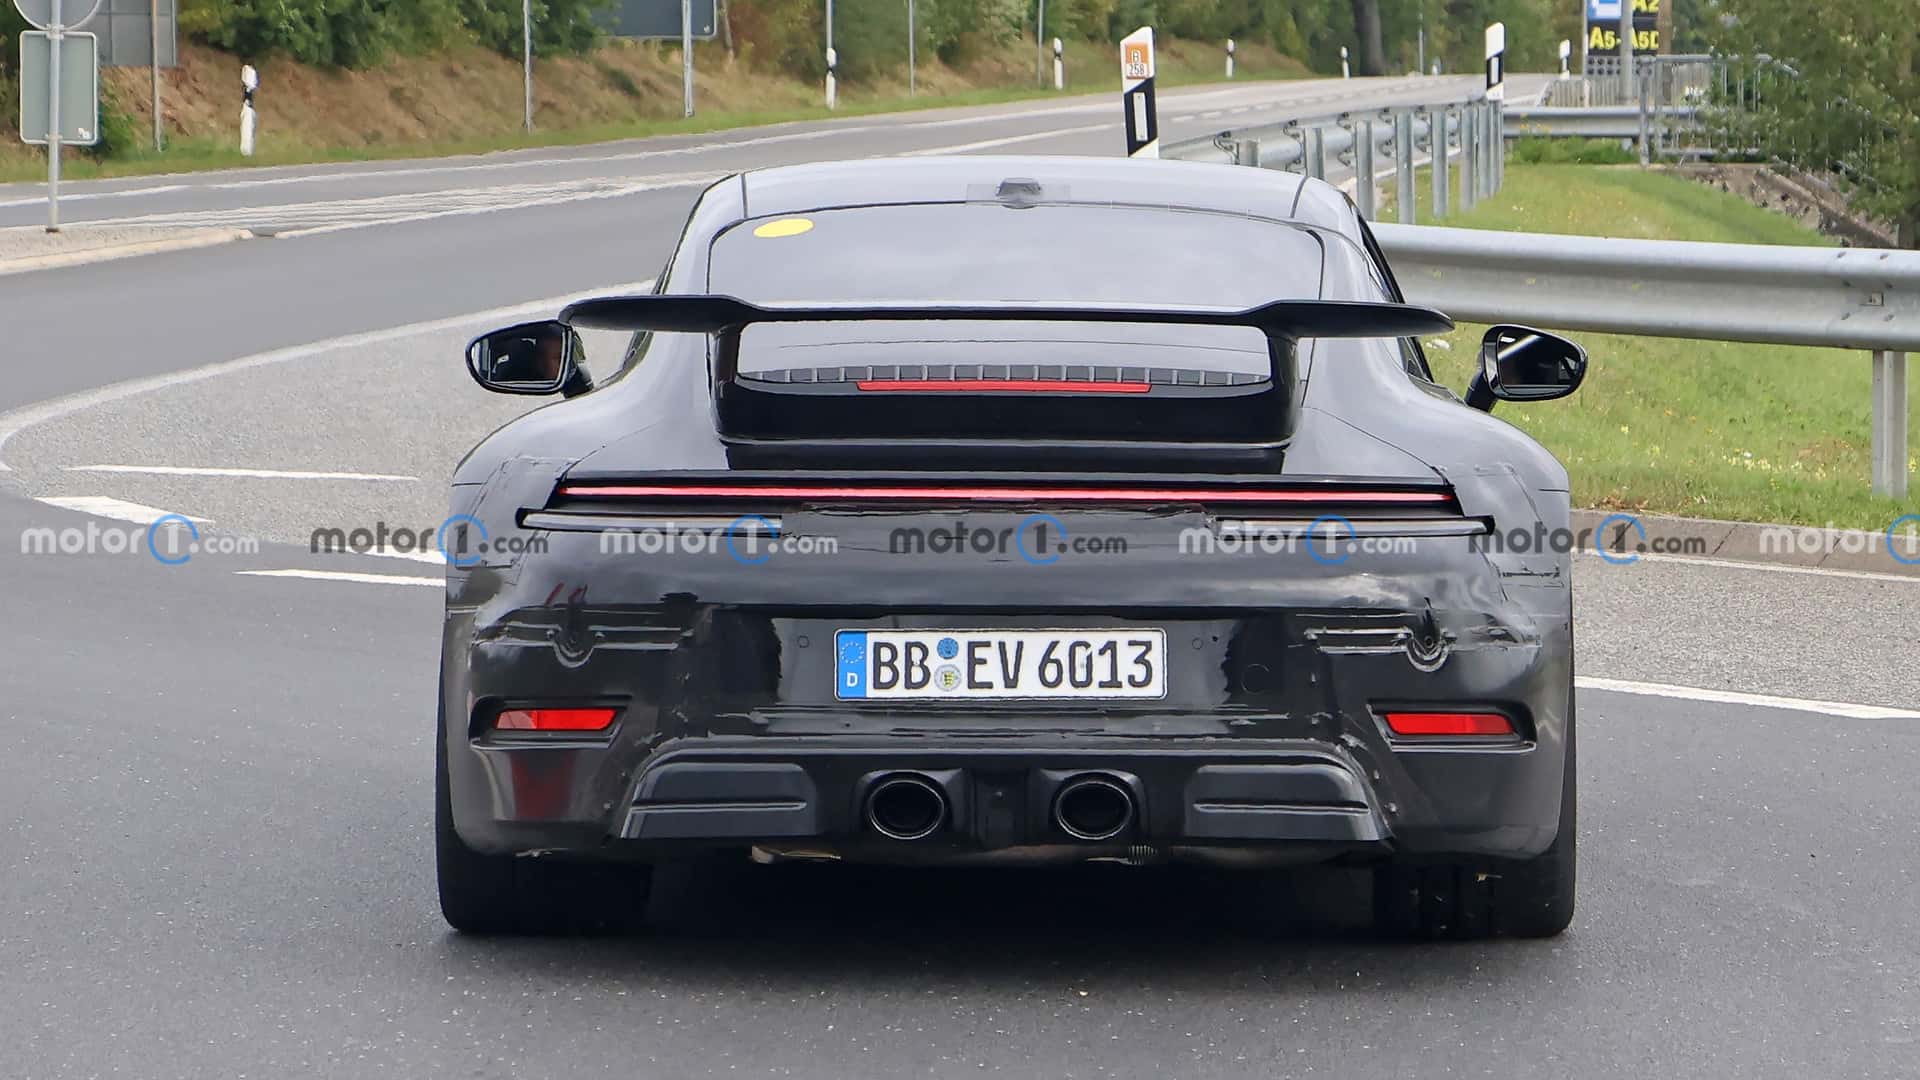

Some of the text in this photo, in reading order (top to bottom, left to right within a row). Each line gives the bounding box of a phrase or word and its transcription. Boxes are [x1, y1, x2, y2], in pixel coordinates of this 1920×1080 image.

[1131, 47, 1141, 63] B
[1129, 63, 1145, 75] 258
[872, 640, 1153, 690] BB EV 6013
[845, 673, 858, 687] D
